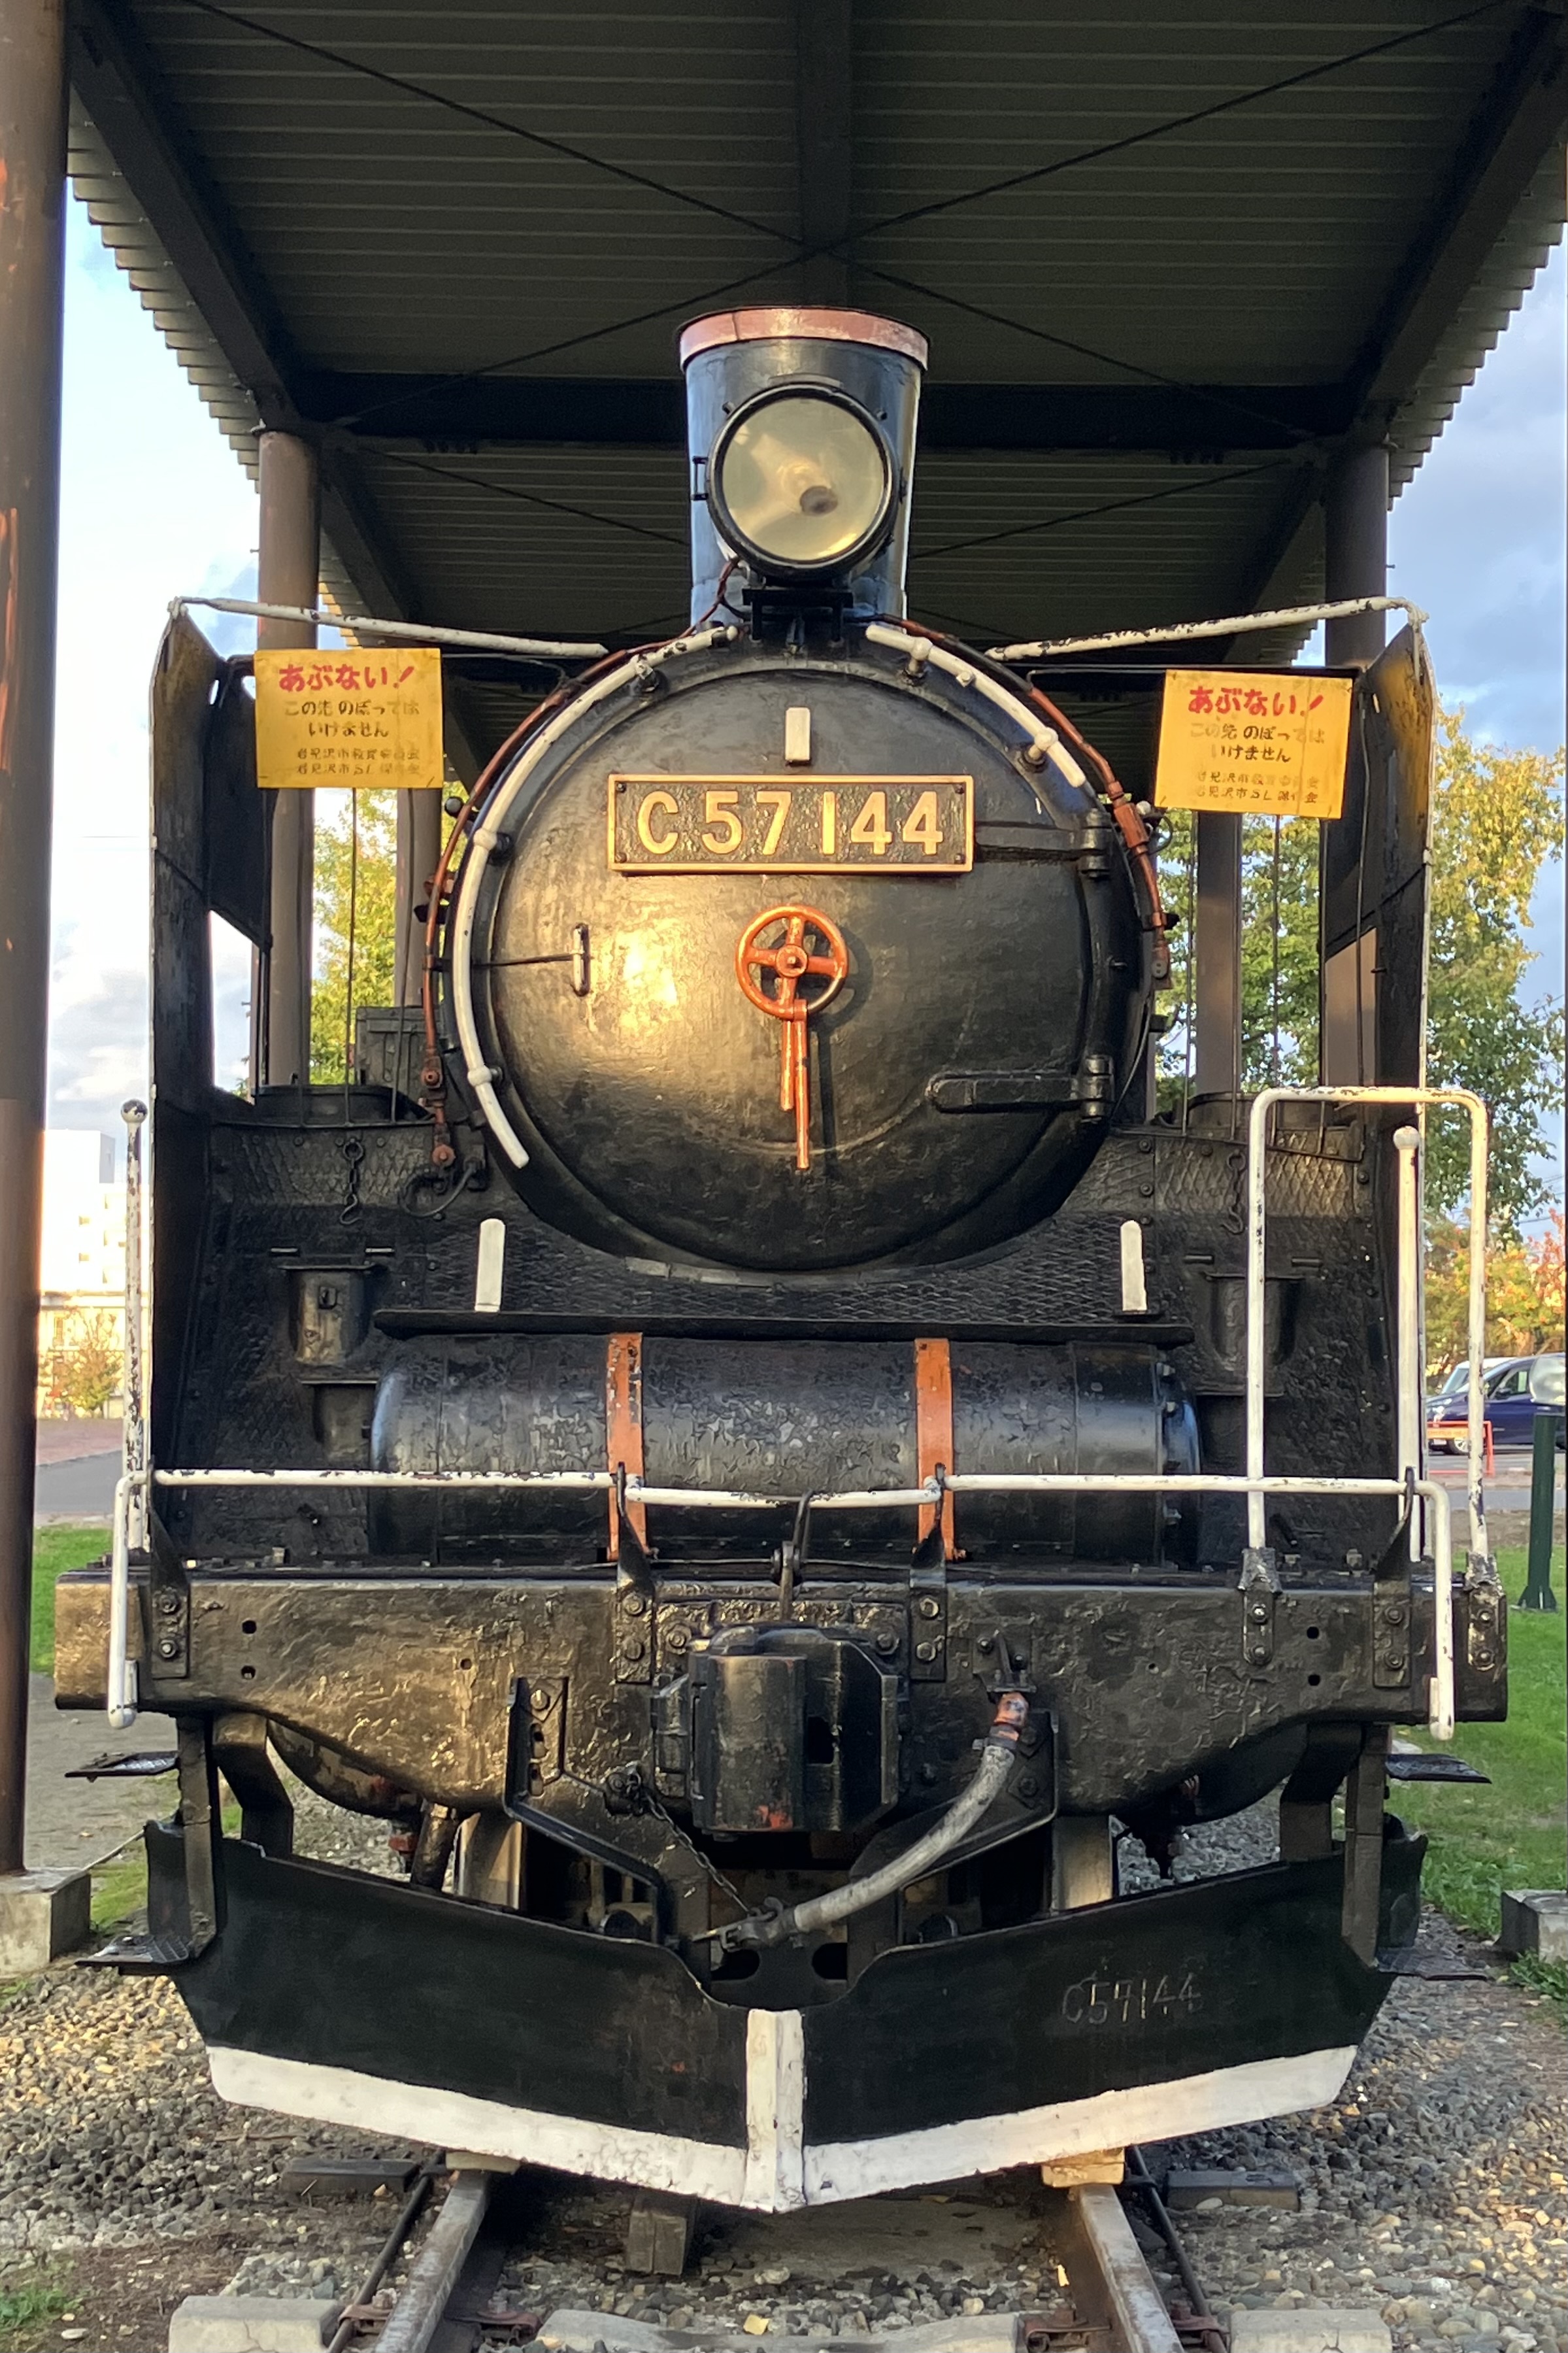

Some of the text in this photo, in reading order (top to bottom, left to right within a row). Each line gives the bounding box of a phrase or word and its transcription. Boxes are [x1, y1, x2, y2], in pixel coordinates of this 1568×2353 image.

[279, 664, 415, 692] あぶない!
[1188, 686, 1324, 717] あぶない!
[309, 721, 390, 738] いけません
[1211, 744, 1292, 763] いけません
